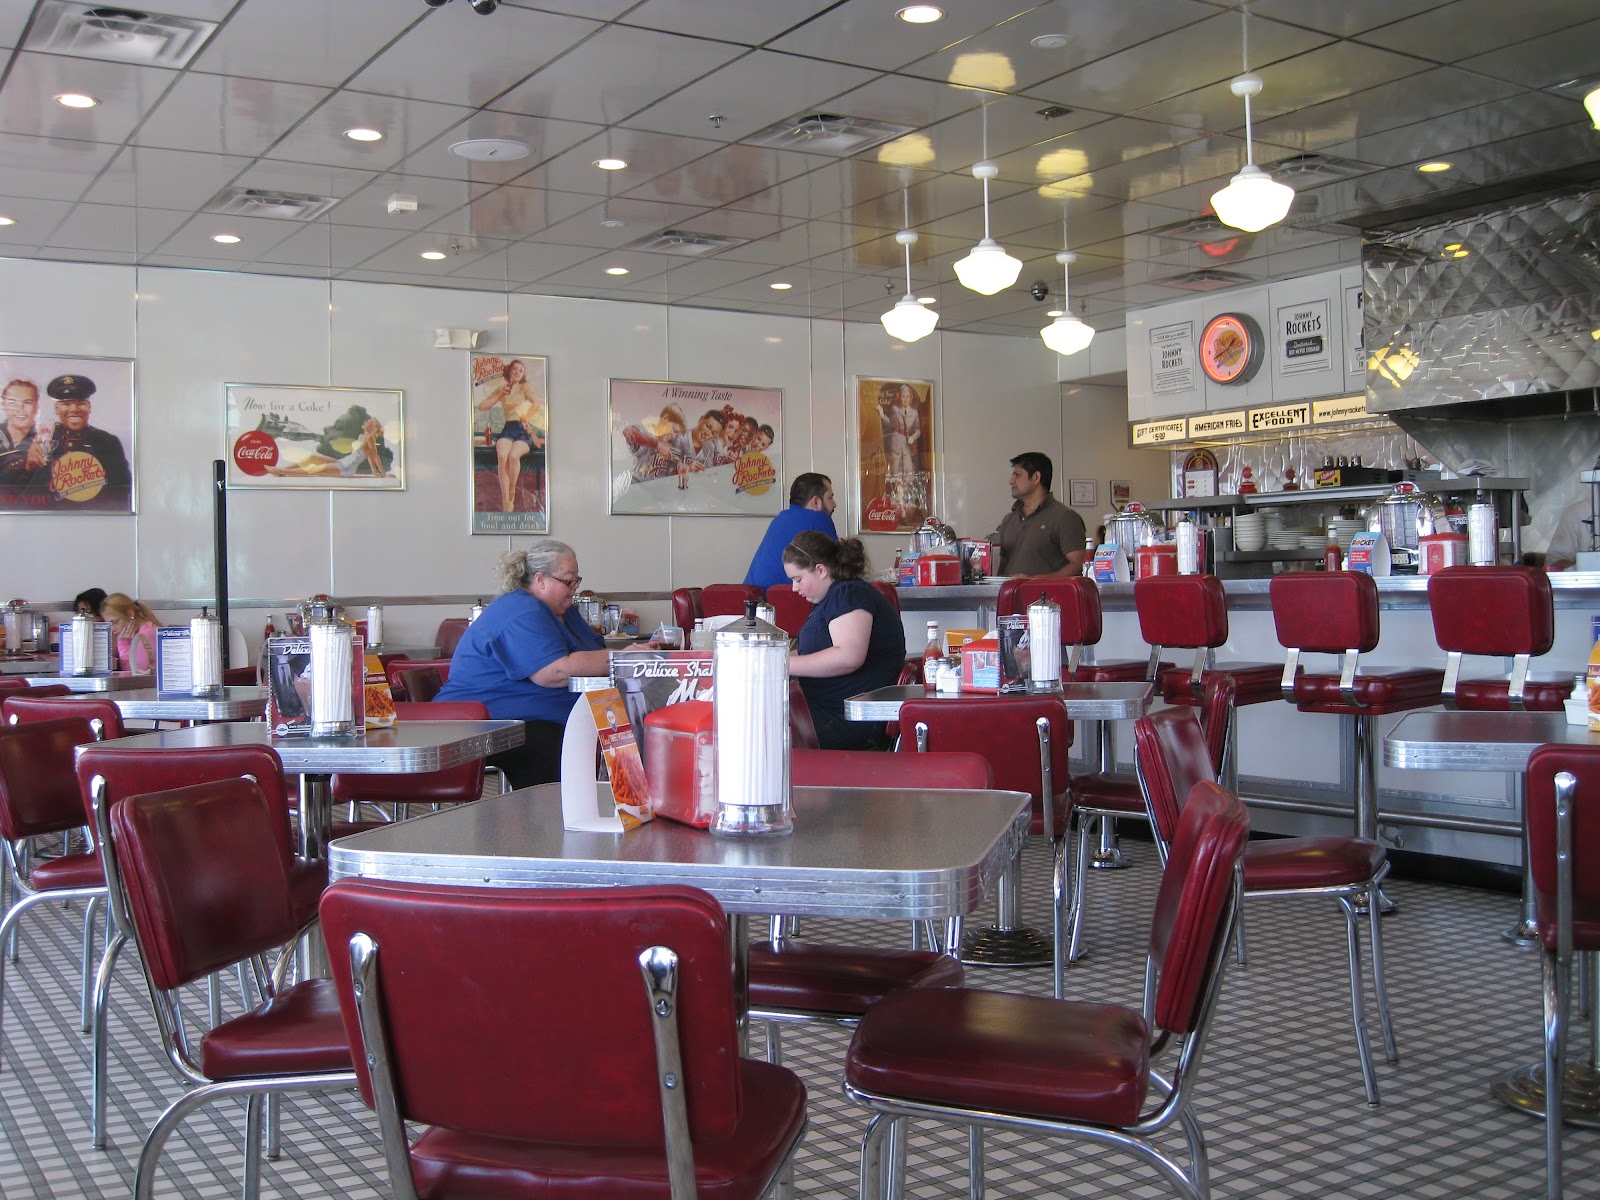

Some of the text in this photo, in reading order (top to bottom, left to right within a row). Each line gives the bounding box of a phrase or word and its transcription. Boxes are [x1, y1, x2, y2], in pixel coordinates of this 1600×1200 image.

[1293, 311, 1313, 322] JOHNNY
[1286, 315, 1322, 336] ROCKETS
[1162, 347, 1182, 360] JOHNNY
[1162, 357, 1184, 369] ROCKETS
[662, 387, 733, 402] A Winning Taste
[244, 396, 266, 411] Now
[270, 400, 285, 411] for
[1194, 418, 1243, 432] AMERICAN FRIES
[1252, 407, 1308, 428] EXCELLENT
[1265, 417, 1294, 426] FOOD
[1136, 422, 1183, 438] GIFT CERTIFICATES
[237, 445, 274, 460] Coca-Cola
[51, 456, 98, 477] Johnny
[735, 455, 769, 472] Johnny
[49, 465, 107, 492] Rockets
[732, 466, 776, 487] Rockets
[1319, 469, 1336, 481] Lipton
[487, 513, 506, 521] Time
[524, 513, 536, 521] for
[481, 522, 541, 530] food and drink
[632, 662, 680, 678] Deluxe
